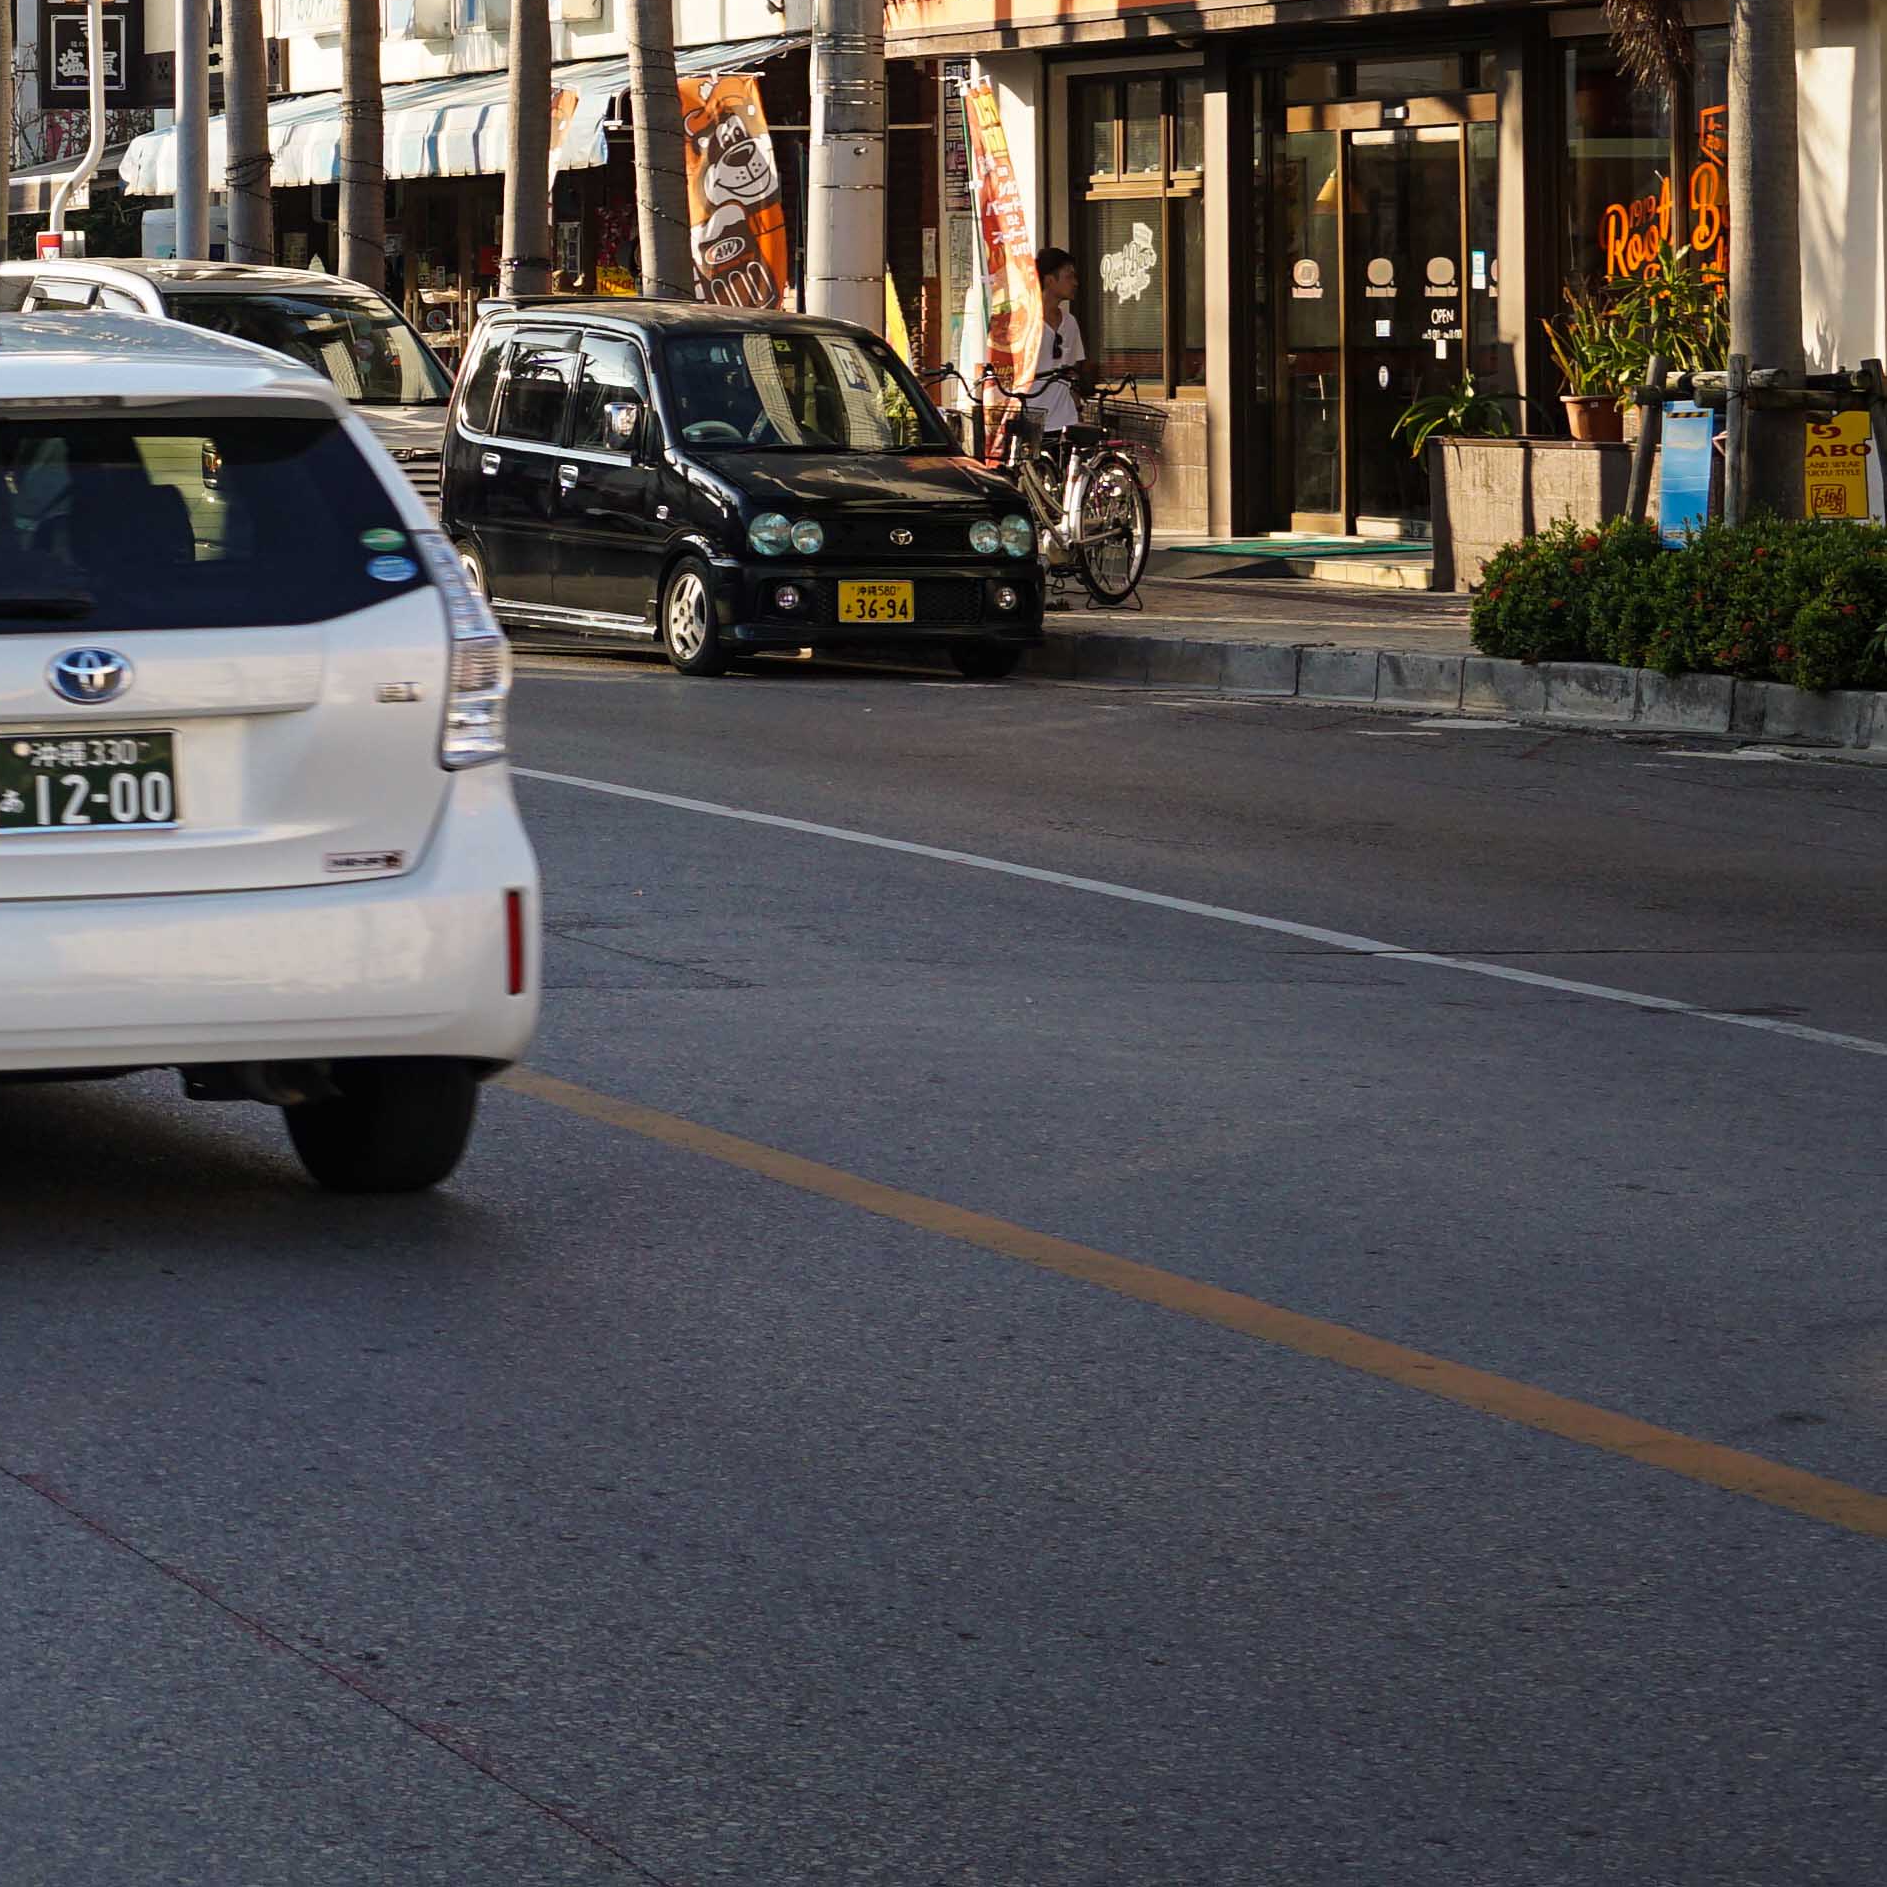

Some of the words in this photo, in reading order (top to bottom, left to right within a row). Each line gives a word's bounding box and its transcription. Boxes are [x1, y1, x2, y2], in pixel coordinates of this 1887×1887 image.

[1430, 308, 1455, 325] OPEN
[1806, 444, 1871, 457] ABO
[856, 598, 909, 620] 36-94
[35, 770, 173, 827] 12-00
